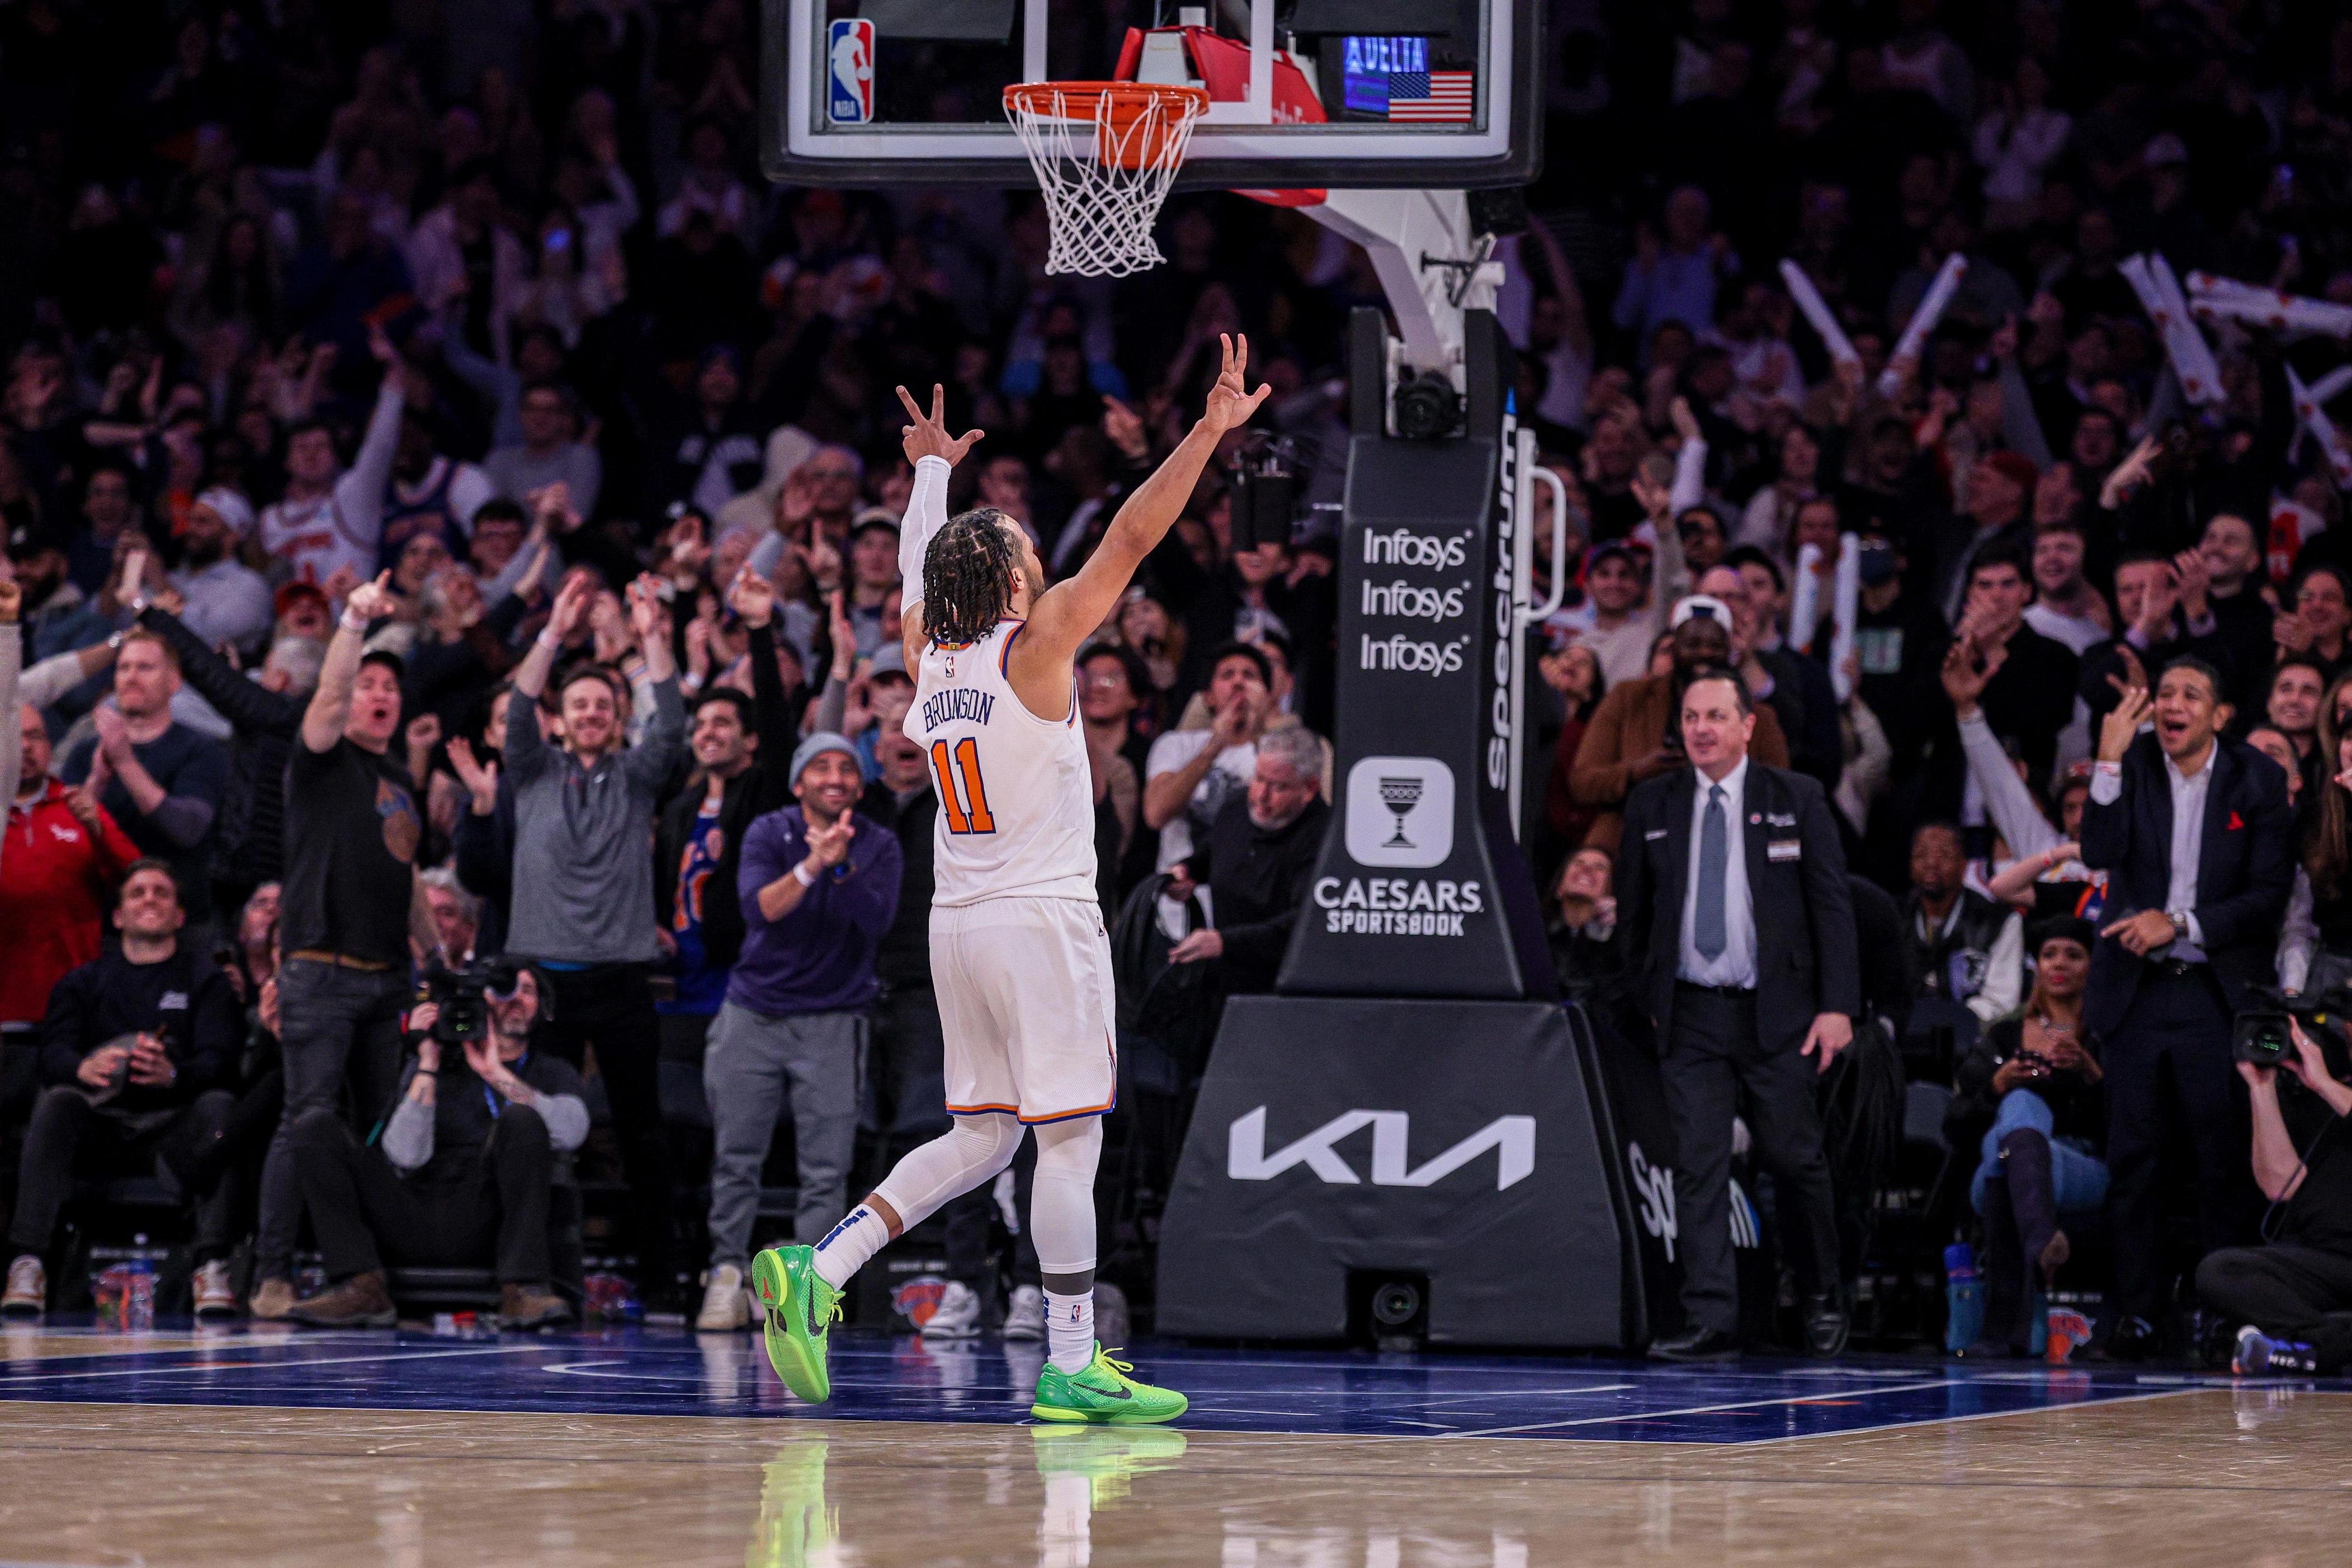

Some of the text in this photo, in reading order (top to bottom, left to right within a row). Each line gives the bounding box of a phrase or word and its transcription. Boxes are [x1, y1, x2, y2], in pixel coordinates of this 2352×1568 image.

[1365, 35, 1425, 73] DELTA
[834, 100, 857, 117] NBA
[1363, 527, 1466, 572] Infosys
[1361, 579, 1464, 623] Infosys
[1487, 414, 1518, 791] Spectrum
[1360, 633, 1463, 678] Infosys
[923, 688, 995, 733] BRUNSON
[930, 736, 996, 835] 11
[1313, 876, 1482, 913] CAESARS
[1326, 909, 1465, 937] SPORTSBOOK
[1227, 1104, 1537, 1192] KIA
